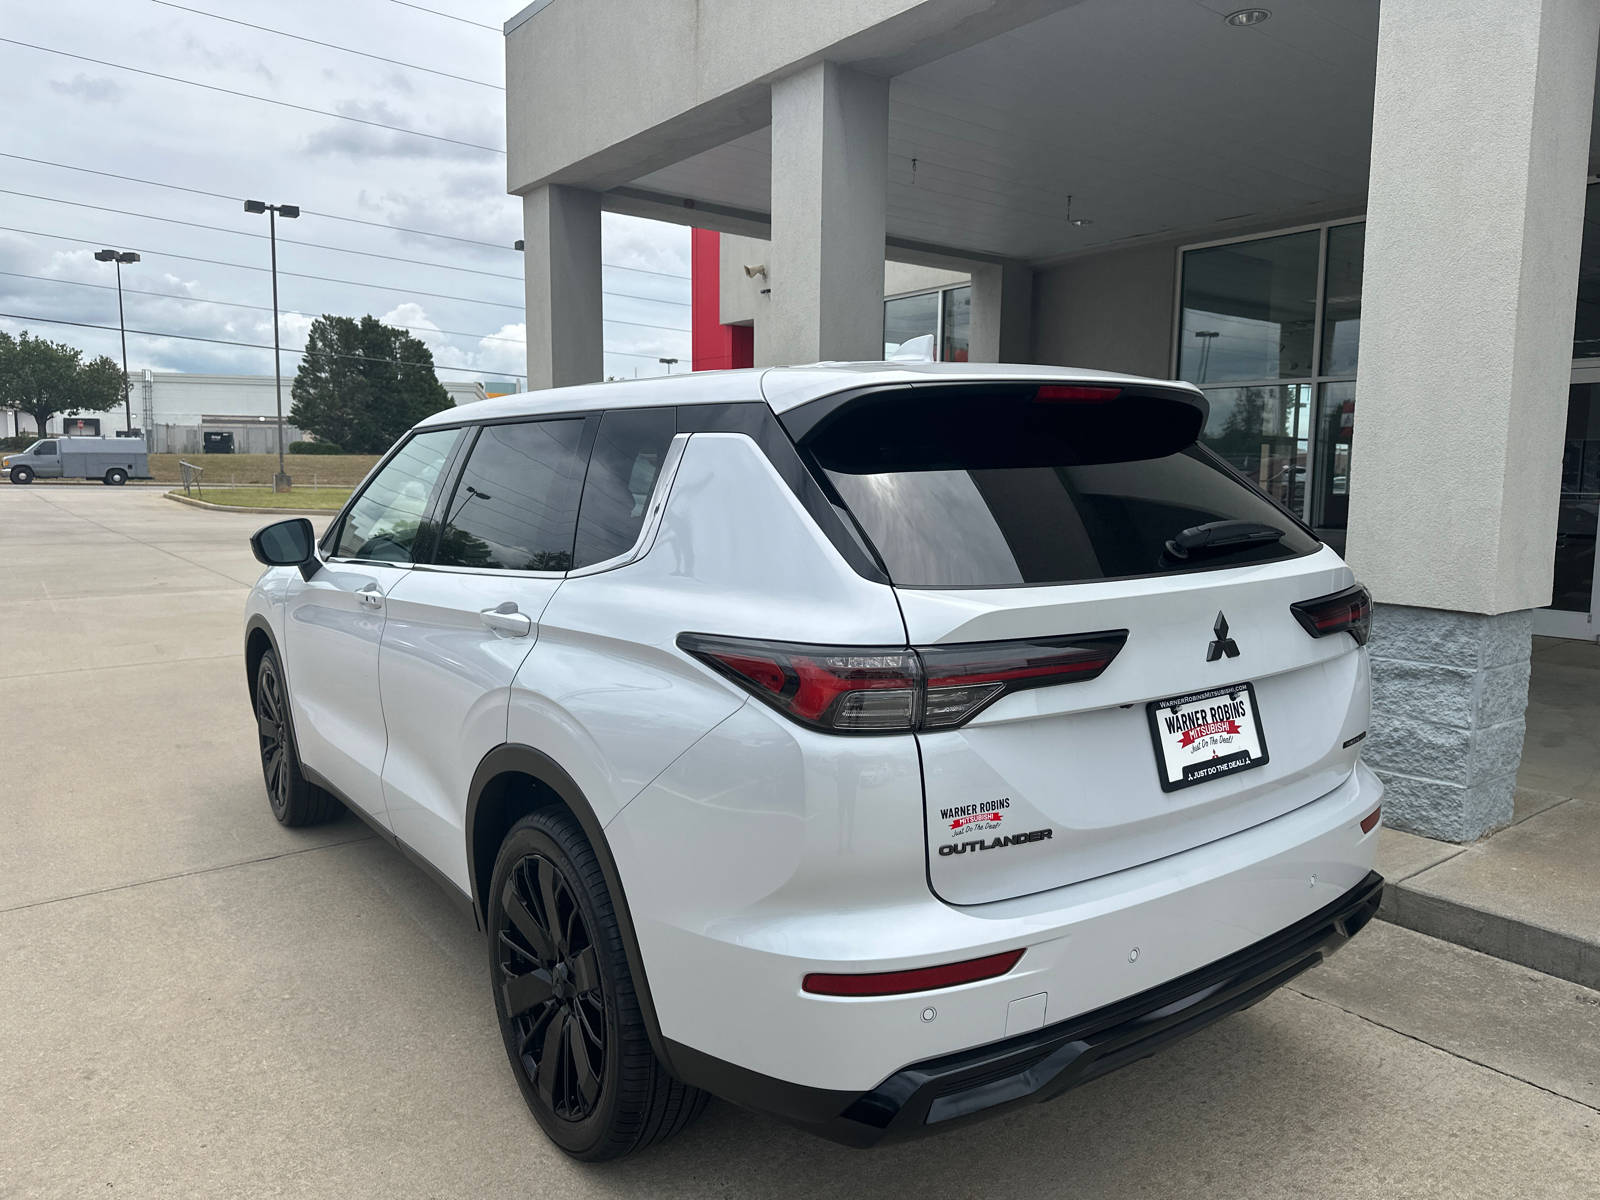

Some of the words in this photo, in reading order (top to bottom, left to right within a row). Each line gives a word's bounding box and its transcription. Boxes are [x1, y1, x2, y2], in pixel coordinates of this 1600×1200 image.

[1165, 710, 1209, 735] WARNER
[1211, 700, 1246, 723] ROBINS
[1188, 721, 1230, 740] MITSUBISHI
[1190, 741, 1201, 754] Just
[1201, 739, 1209, 749] Do
[1209, 736, 1218, 746] The
[1193, 769, 1208, 779] JUST
[1208, 766, 1217, 775] DO
[1216, 763, 1229, 772] THE
[1228, 758, 1245, 770] DEAL!
[940, 803, 977, 820] WARNER
[979, 797, 1010, 813] ROBINS
[959, 813, 994, 825] MITSUBISHI
[951, 827, 964, 838] Just
[965, 825, 973, 834] Do
[974, 823, 984, 832] The
[938, 828, 1053, 856] OUTLANDER
